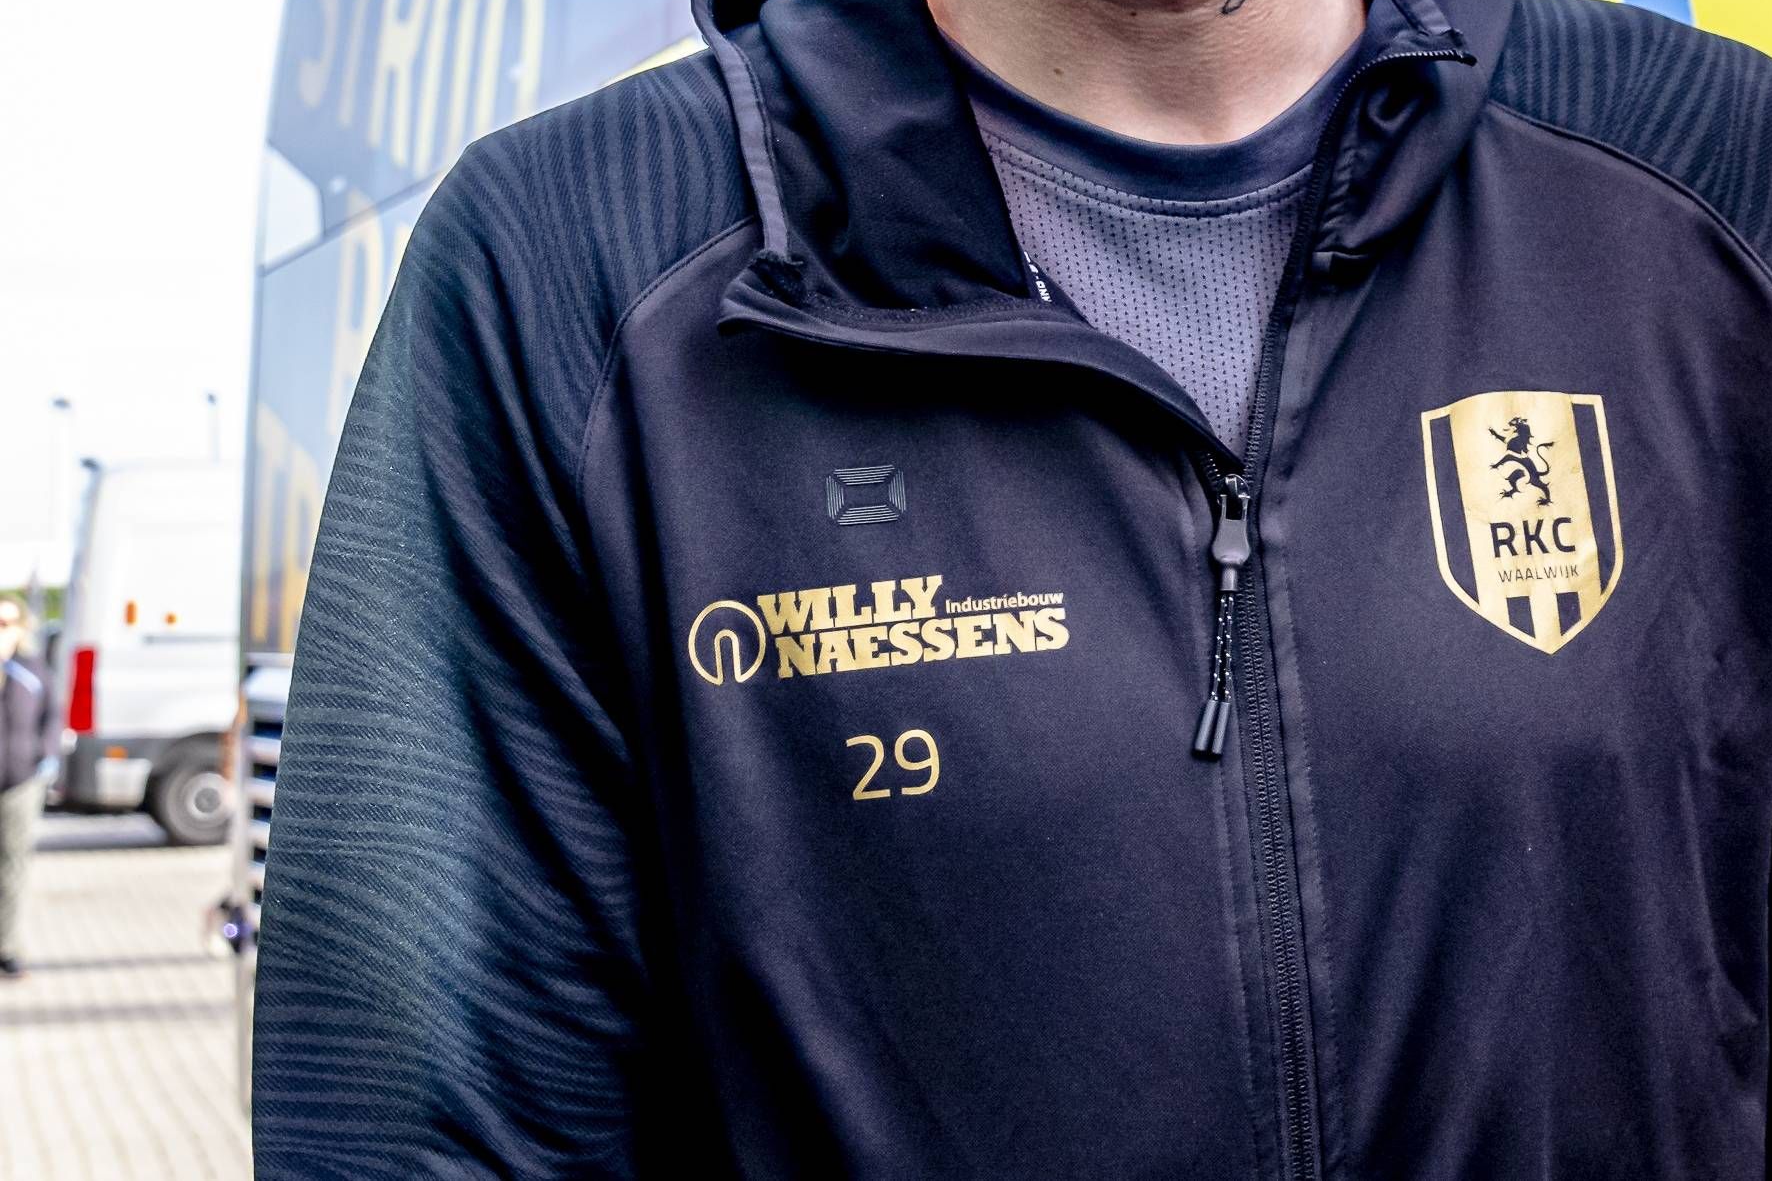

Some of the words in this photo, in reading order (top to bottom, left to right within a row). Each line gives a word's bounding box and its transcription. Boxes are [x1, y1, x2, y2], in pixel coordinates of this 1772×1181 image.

[1489, 516, 1577, 559] RKC
[756, 574, 943, 635] WILLY
[945, 592, 1064, 615] Industriebouw
[1497, 564, 1580, 584] WAALWIJK
[775, 607, 1070, 679] NAESSENS
[845, 728, 941, 801] 29
